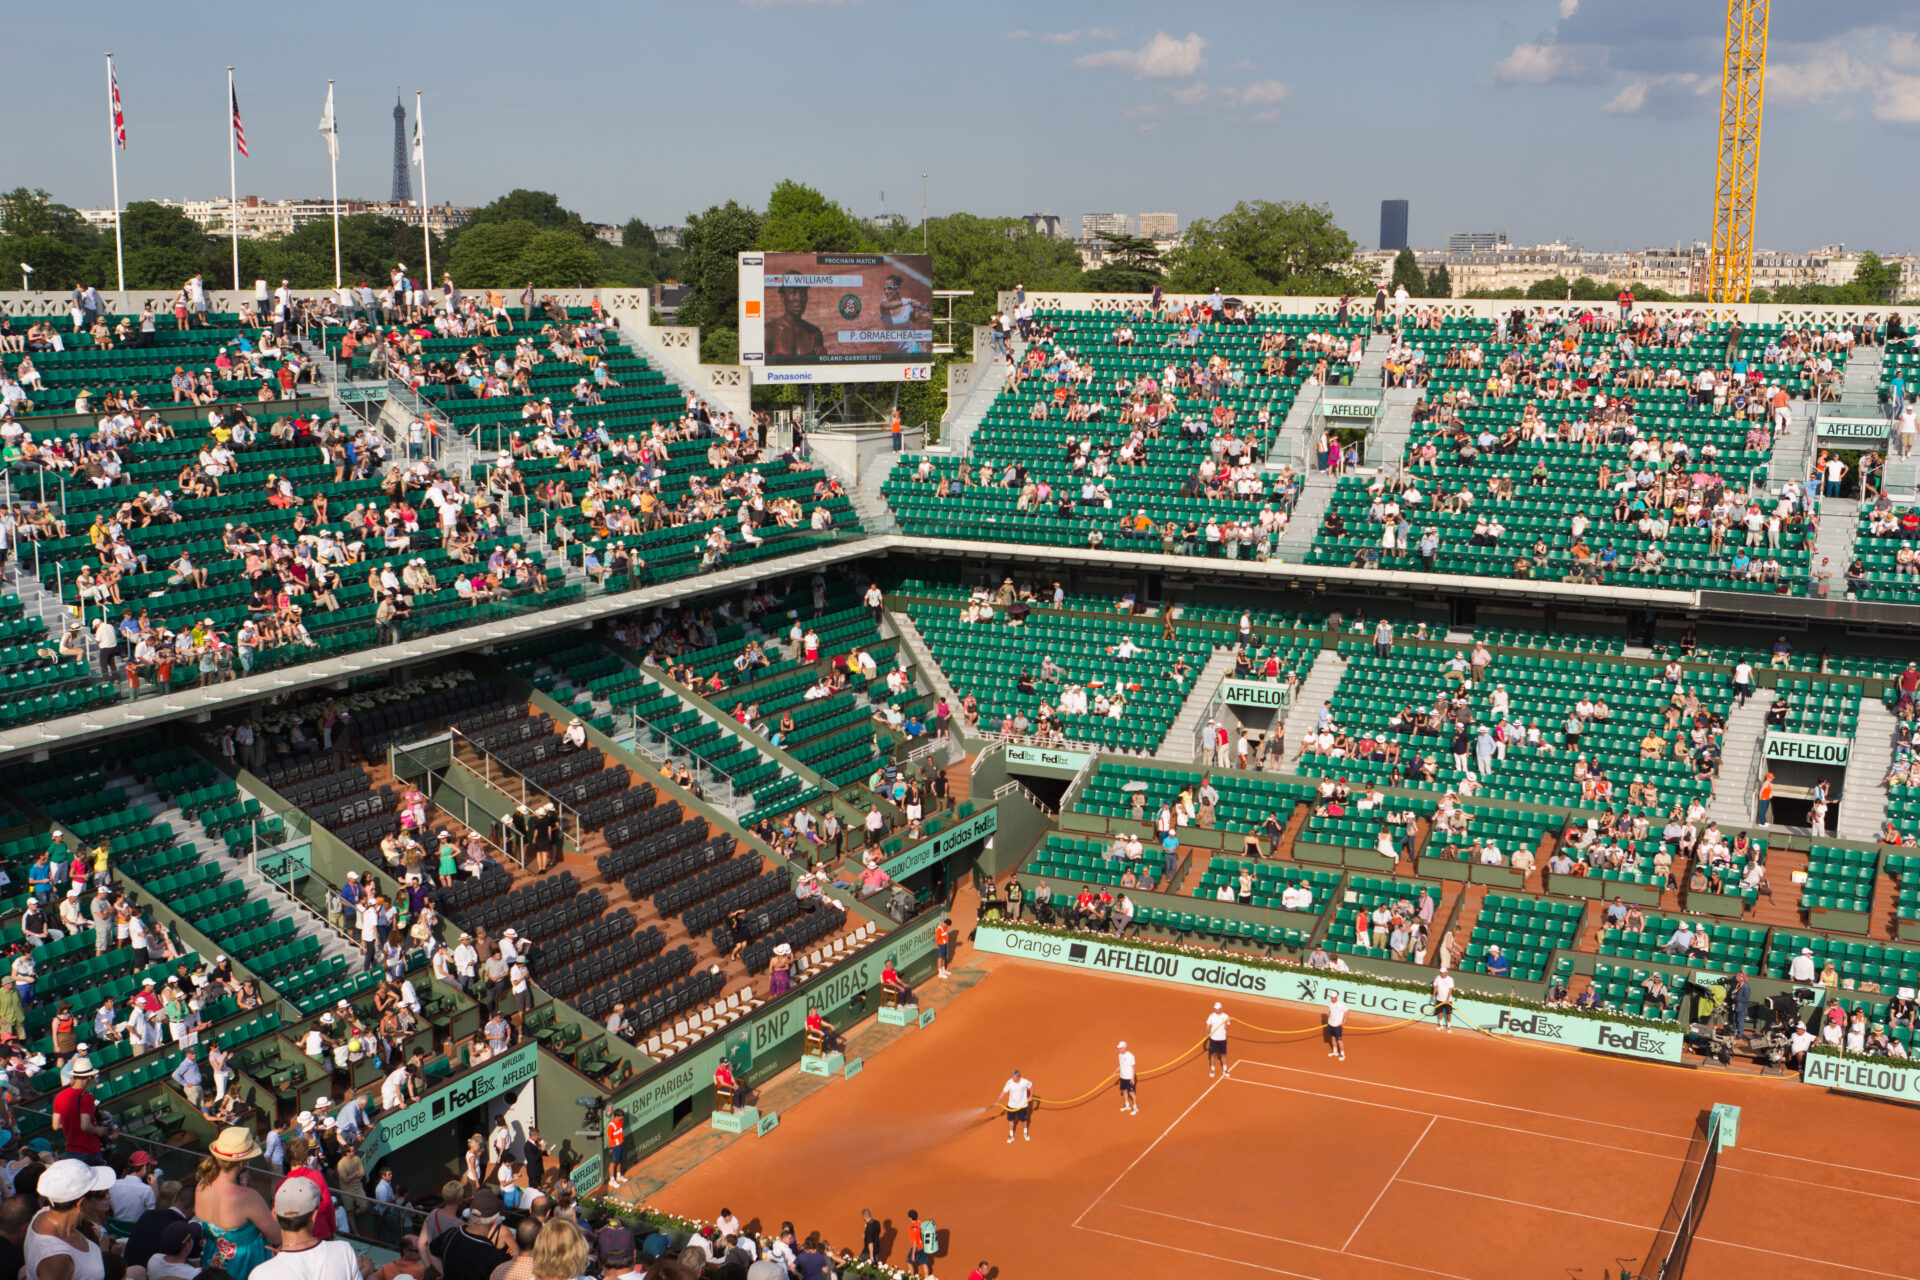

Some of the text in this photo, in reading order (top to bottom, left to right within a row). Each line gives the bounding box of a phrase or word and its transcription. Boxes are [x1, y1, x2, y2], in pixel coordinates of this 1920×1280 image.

[784, 275, 834, 285] V. WILLIAMS
[850, 331, 914, 341] P. ORMAECHEA
[767, 372, 813, 381] Panasonic
[1331, 405, 1377, 417] AFFLELOU
[1827, 424, 1882, 437] AFFLELOU
[1226, 687, 1290, 705] AFFLELOU
[1767, 740, 1848, 762] AFFLELOU
[905, 849, 930, 870] Orange
[943, 828, 972, 852] adidas
[974, 814, 995, 837] FedEx
[261, 856, 305, 880] FedEx
[900, 939, 913, 956] BNP
[1005, 933, 1666, 1055] Orange AFFLELOU adidas PEUGEO FedEx FedEx
[755, 962, 869, 1051] BNP PARIBAS
[501, 1052, 525, 1071] AFFLELOU
[1807, 1060, 1907, 1092] AFFLELOU
[380, 1060, 537, 1144] Orange FedEx AFFLELOU
[633, 1091, 653, 1115] BNP
[655, 1067, 694, 1102] PARIBAS
[574, 1160, 600, 1183] AFFLELOU
[577, 1172, 600, 1195] FFLELOU
